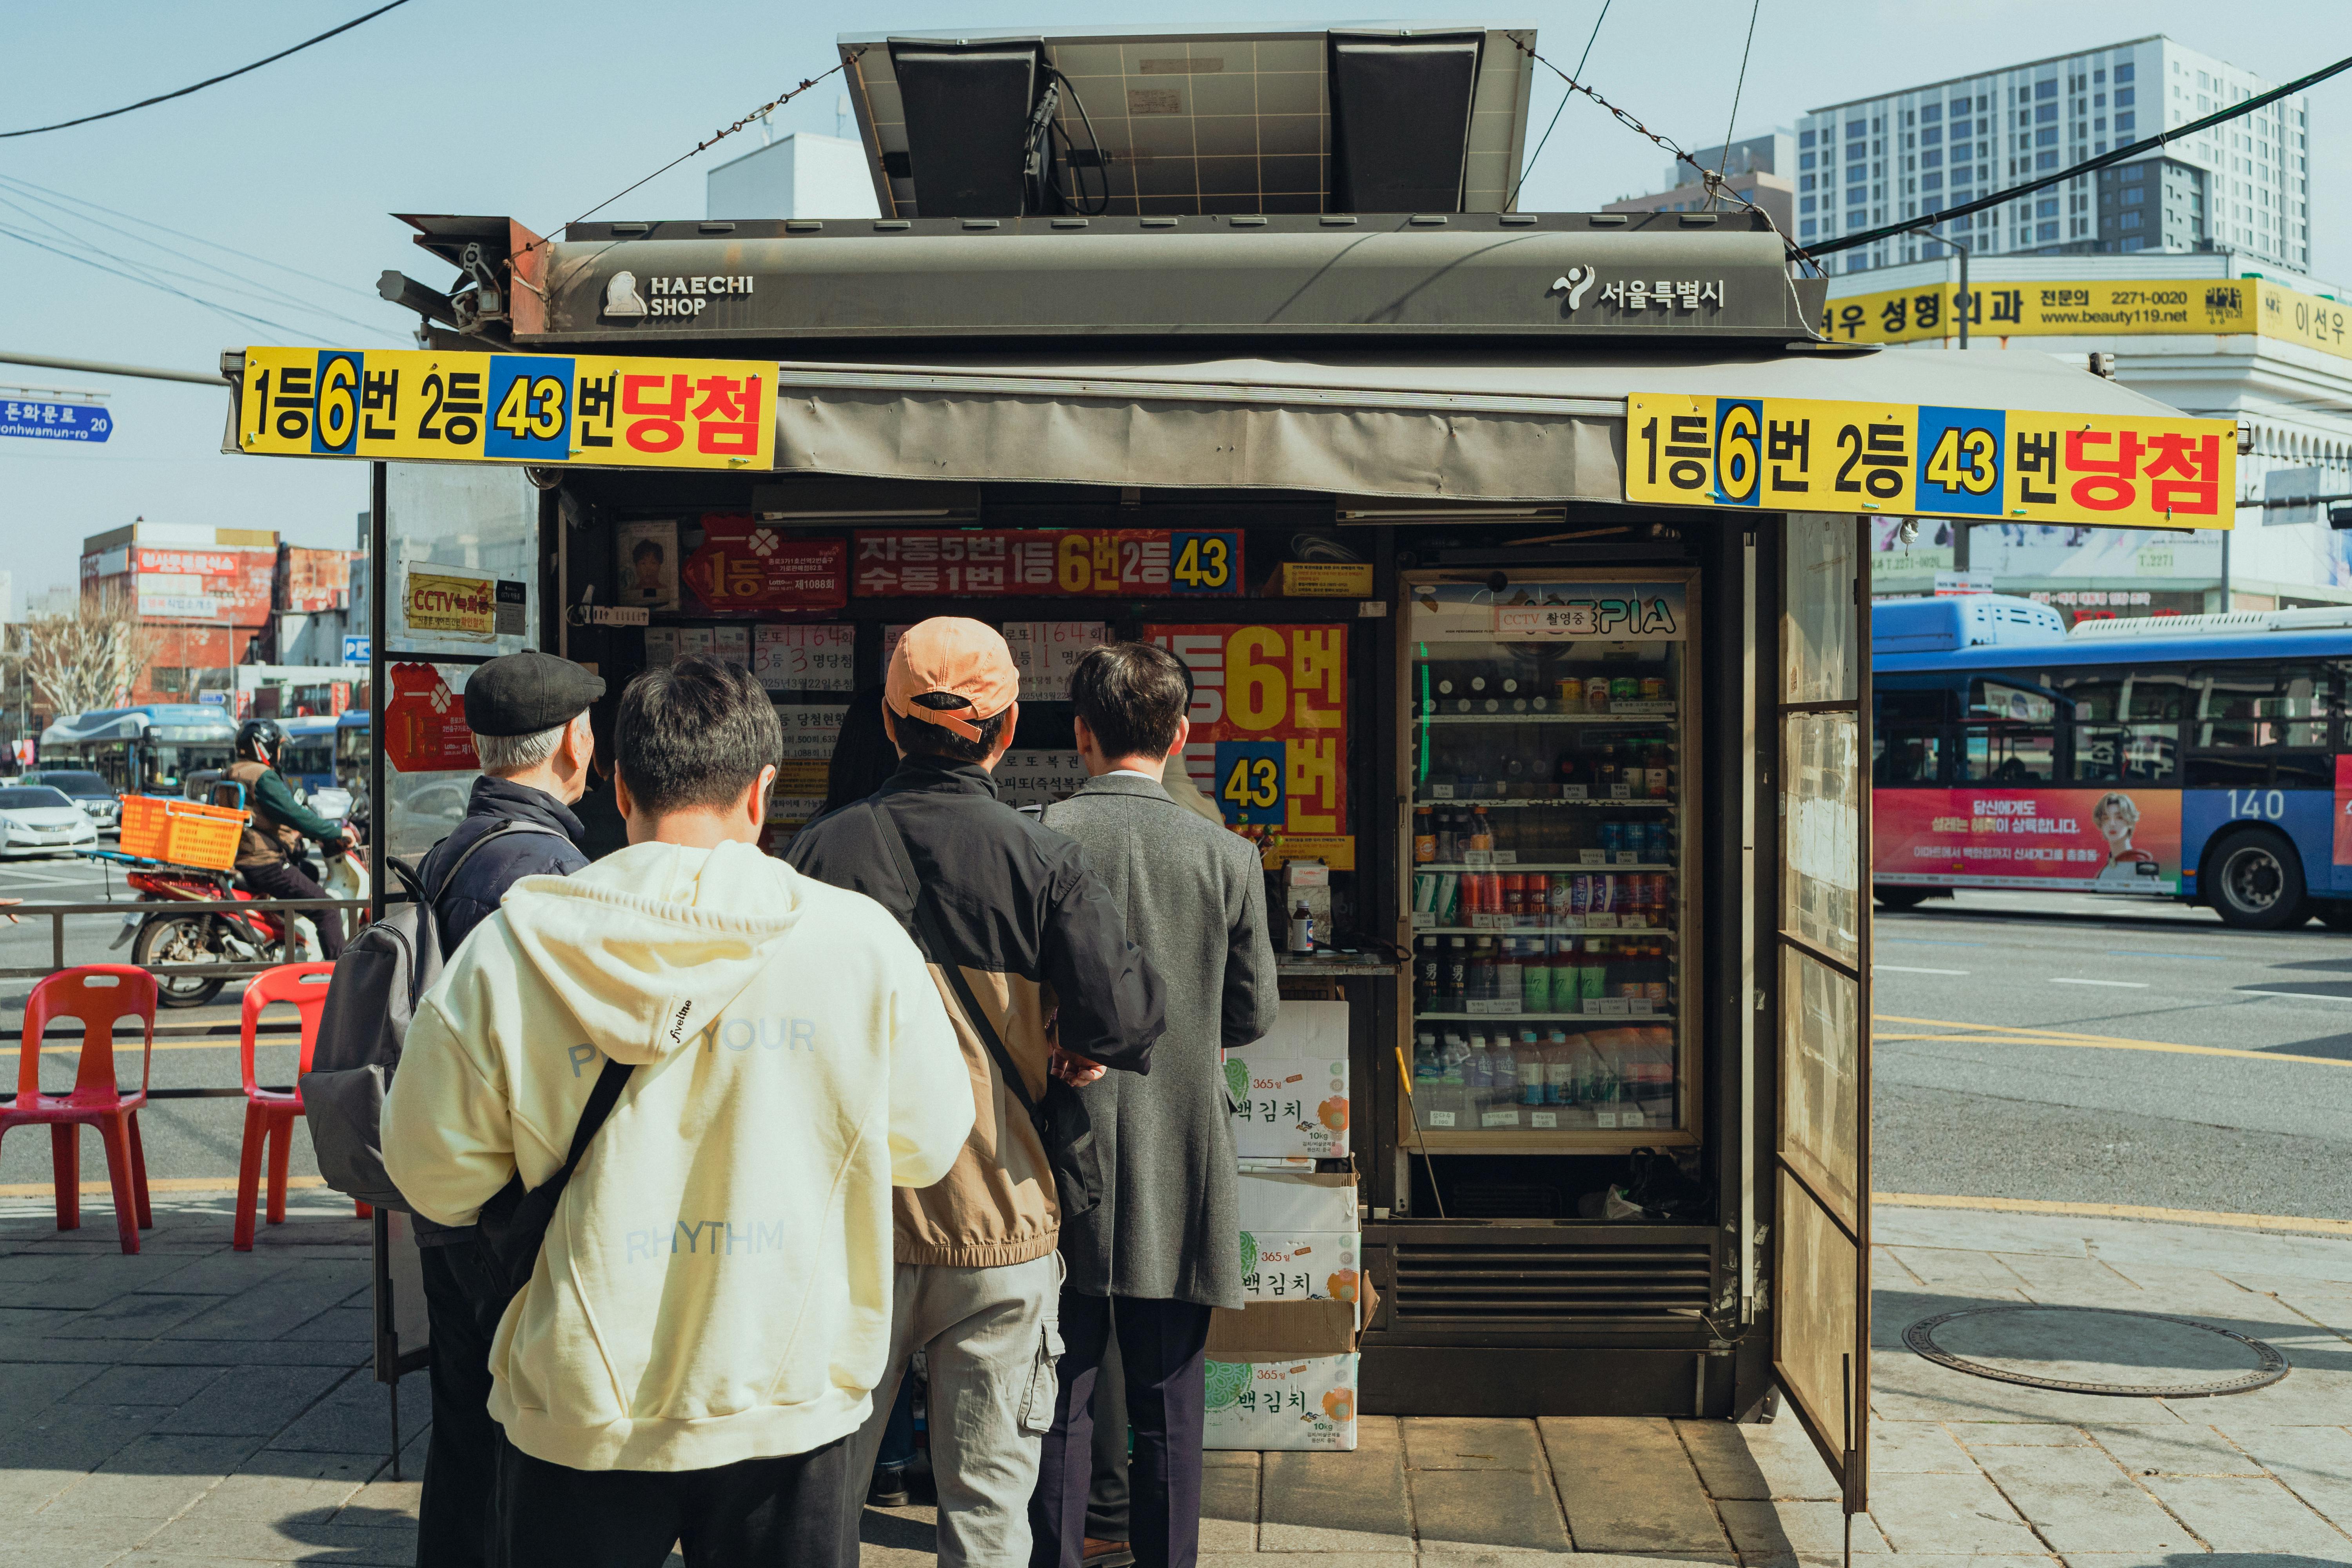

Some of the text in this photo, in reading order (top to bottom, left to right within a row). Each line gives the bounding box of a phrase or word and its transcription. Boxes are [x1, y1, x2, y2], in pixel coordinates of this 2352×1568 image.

[651, 276, 754, 296] HAECHI
[1601, 280, 1724, 309] 서울특별시
[650, 298, 707, 316] SHOP
[2041, 290, 2089, 307] 전문의
[2111, 291, 2188, 305] 2271-0020
[2041, 309, 2188, 326] www.beauty119.net
[5, 403, 76, 424] 돈화문로
[0, 423, 88, 439] onhwamun-ro
[91, 417, 107, 432] 20
[708, 550, 765, 597] 1등
[795, 579, 835, 590] 제1088회
[414, 589, 454, 612] CCTV
[1503, 612, 1584, 626] CCTV 촬영중
[2227, 788, 2285, 820] 140
[670, 999, 692, 1044] fiveline
[702, 1018, 816, 1053] YOUR
[1237, 1100, 1301, 1123] 백김치
[1309, 1132, 1328, 1141] 10kg
[626, 1220, 784, 1264] RHYTHM
[1243, 1272, 1310, 1296] 백김치
[1238, 1390, 1305, 1414] 백김치
[1314, 1423, 1333, 1431] 10kg
